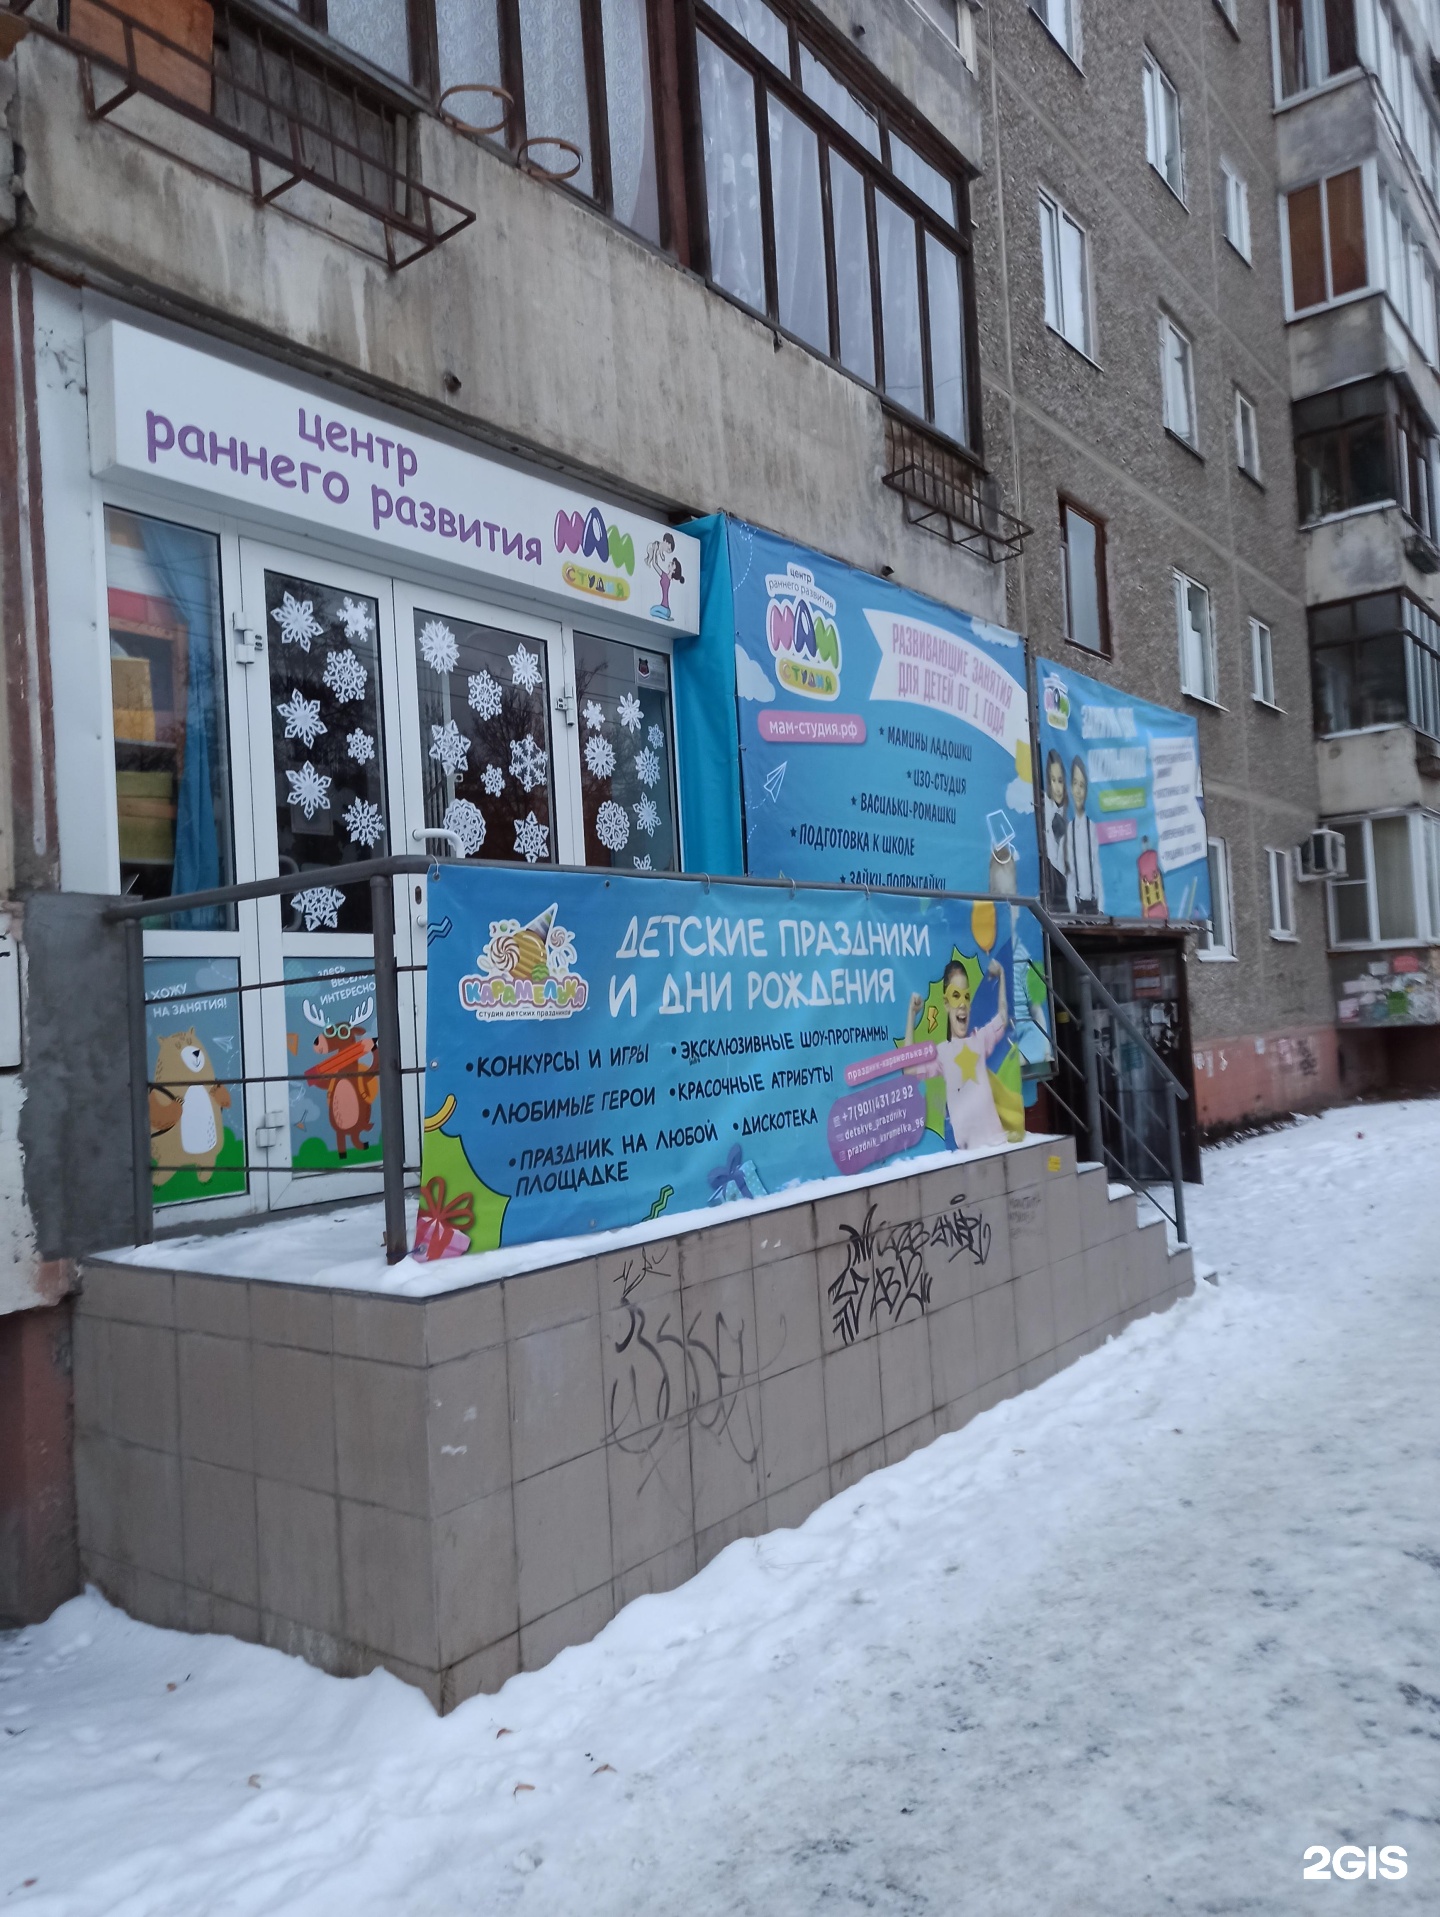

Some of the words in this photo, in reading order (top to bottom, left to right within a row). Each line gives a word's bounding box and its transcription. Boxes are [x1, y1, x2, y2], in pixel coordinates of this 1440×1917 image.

[298, 407, 418, 486] центр
[146, 409, 350, 504] раннего
[371, 483, 542, 566] развития
[790, 568, 812, 585] центр
[769, 579, 799, 591] раннего
[801, 586, 834, 610] развития
[782, 663, 833, 692] СТУДИЯ
[892, 622, 968, 678] РАЗВИВАЮЩИЕ
[972, 656, 1013, 710] ЗАНЯТИЯ
[898, 661, 919, 697] ДЛЯ
[923, 668, 954, 707] ДЕТЕЙ
[957, 682, 970, 713] ОТ
[973, 692, 979, 719] 1
[983, 698, 1006, 737] ГОДА
[769, 720, 857, 739] мам-студия.рф
[887, 726, 928, 752] МАМИНЫ
[930, 737, 972, 762] ЛАДОШКИ
[913, 769, 967, 797] ИЗО-СТУДИЯ
[860, 792, 956, 825] ВАСИЛЬКИ-РОМАШКИ
[799, 824, 869, 853] ПОДГОТОВКА
[873, 833, 880, 852] К
[882, 835, 915, 856] ШКОЛЕ
[616, 914, 768, 958] ДЕТСКИЕ
[779, 919, 931, 958] ПРАЗДНИКИ
[151, 982, 187, 1000] ХОЖУ
[153, 1007, 170, 1018] НА
[172, 997, 228, 1015] ЗАНЯТИЯ!
[320, 981, 376, 1006] ИНТЕРЕСНО
[464, 979, 586, 1006] КАРАМЕЛЬКА
[609, 973, 638, 1018] И
[658, 970, 733, 1015] ДНИ
[748, 968, 896, 1010] РОЖДЕНИЯ
[478, 1010, 504, 1019] студия
[505, 1010, 535, 1018] детских
[536, 1009, 571, 1018] праздников
[681, 1032, 795, 1059] ЭКСКЛЮЗИВНЫЕ
[800, 1025, 889, 1048] ШОУ-ПРОГРАММЫ
[476, 1050, 580, 1078] КОНКУРСЫ
[588, 1048, 601, 1069] И
[610, 1043, 649, 1067] ИГРЫ
[678, 1073, 765, 1101] КРАСОЧНЫЕ
[771, 1065, 834, 1090] АТРИБУТЫ
[891, 1088, 902, 1104] 22
[902, 1084, 914, 1100] 92
[491, 1094, 595, 1126] ЛЮБИМЫЕ
[601, 1086, 656, 1112] ГЕРОИ
[741, 1107, 818, 1136] ДИСКОТЕКА
[520, 1137, 615, 1171] ПРАЗДНИК
[622, 1132, 648, 1155] НА
[655, 1118, 719, 1149] ЛЮБОЙ
[516, 1160, 630, 1197] ПЛОЩАДКЕ
